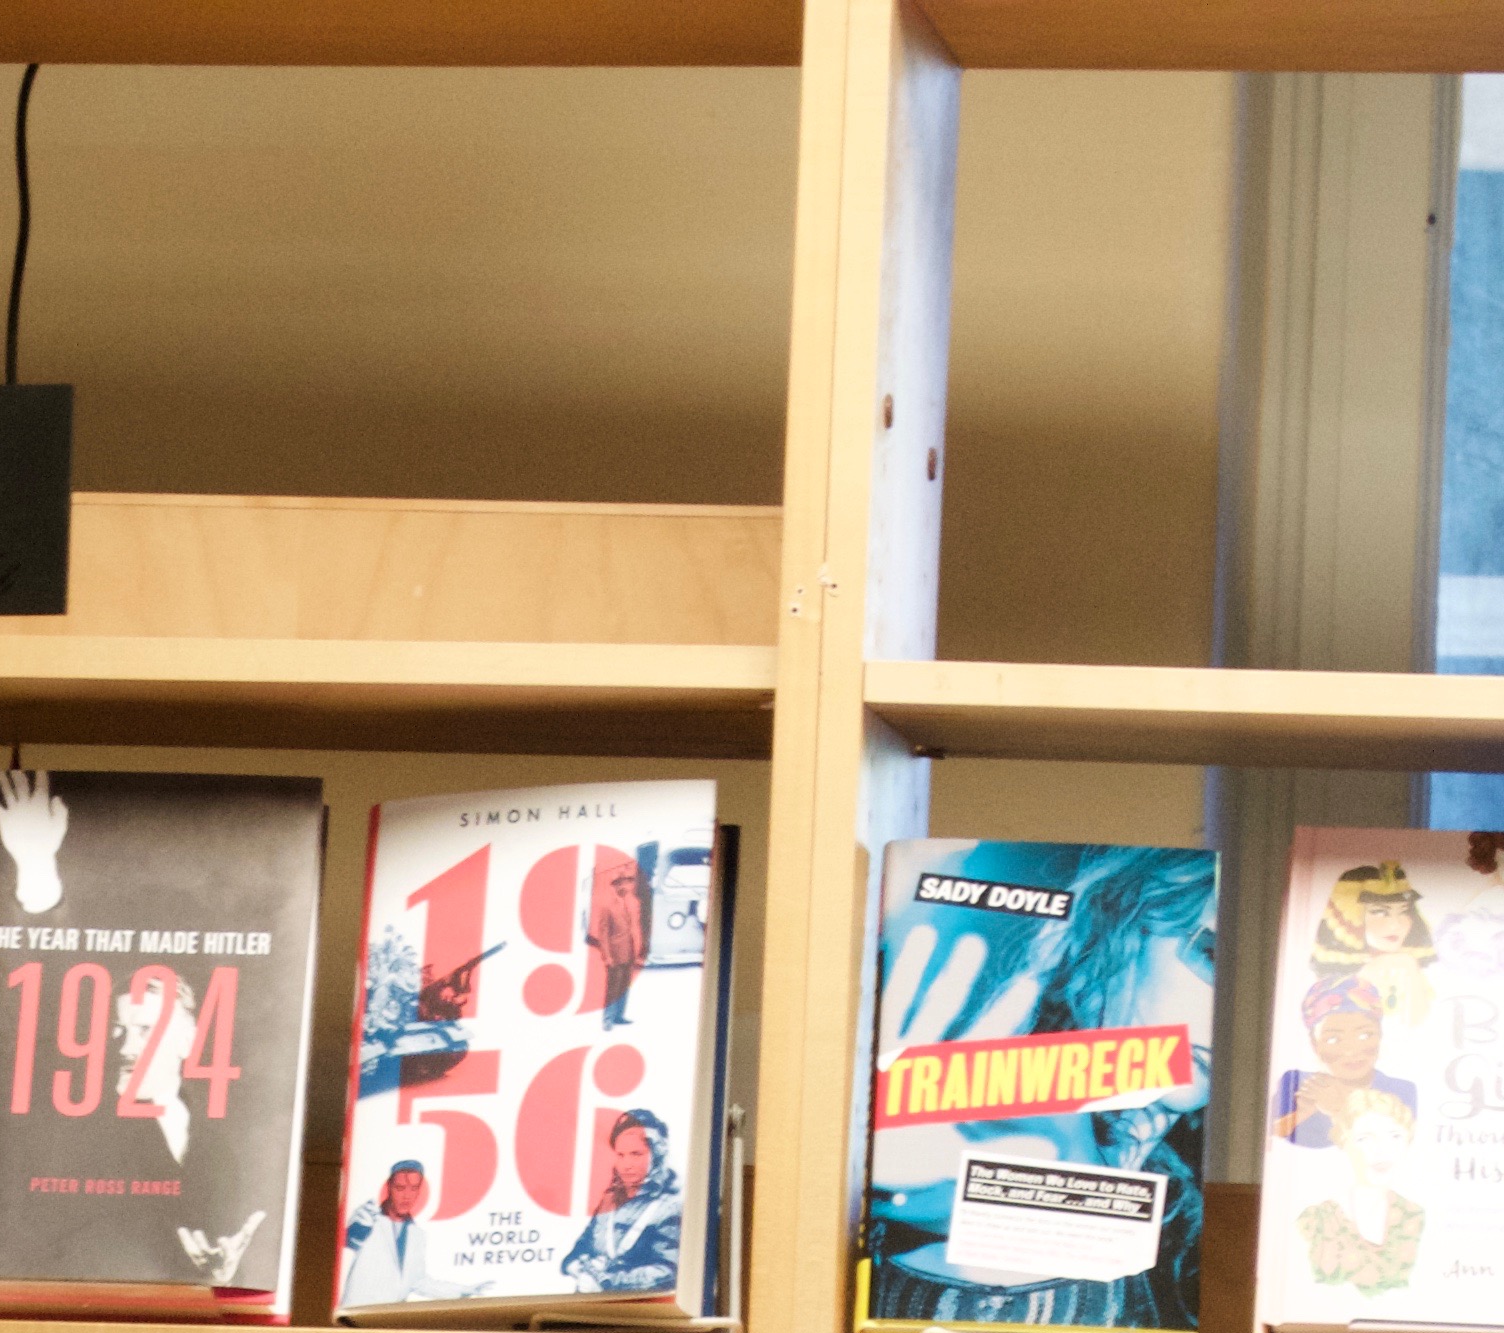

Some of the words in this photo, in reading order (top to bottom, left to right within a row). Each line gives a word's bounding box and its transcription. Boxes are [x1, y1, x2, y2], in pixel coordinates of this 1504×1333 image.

[459, 806, 542, 828] SIMON
[558, 803, 619, 821] HALL
[920, 879, 987, 908] SADY
[989, 886, 1070, 917] DOYLE
[27, 926, 80, 952] YEAR
[85, 927, 134, 953] THAT
[139, 930, 200, 955] MADE
[204, 931, 272, 956] HITLER
[407, 842, 643, 1018] 19
[7, 962, 242, 1119] 1924
[885, 1036, 1181, 1117] TRAINWRECK
[397, 1044, 647, 1221] 56
[29, 1177, 78, 1193] PETER
[83, 1179, 125, 1194] ROSS
[130, 1180, 182, 1197] RANGE
[488, 1212, 523, 1227] THE
[467, 1230, 540, 1246] WORLD
[453, 1250, 470, 1266] IN
[474, 1247, 556, 1265] REVOLT
